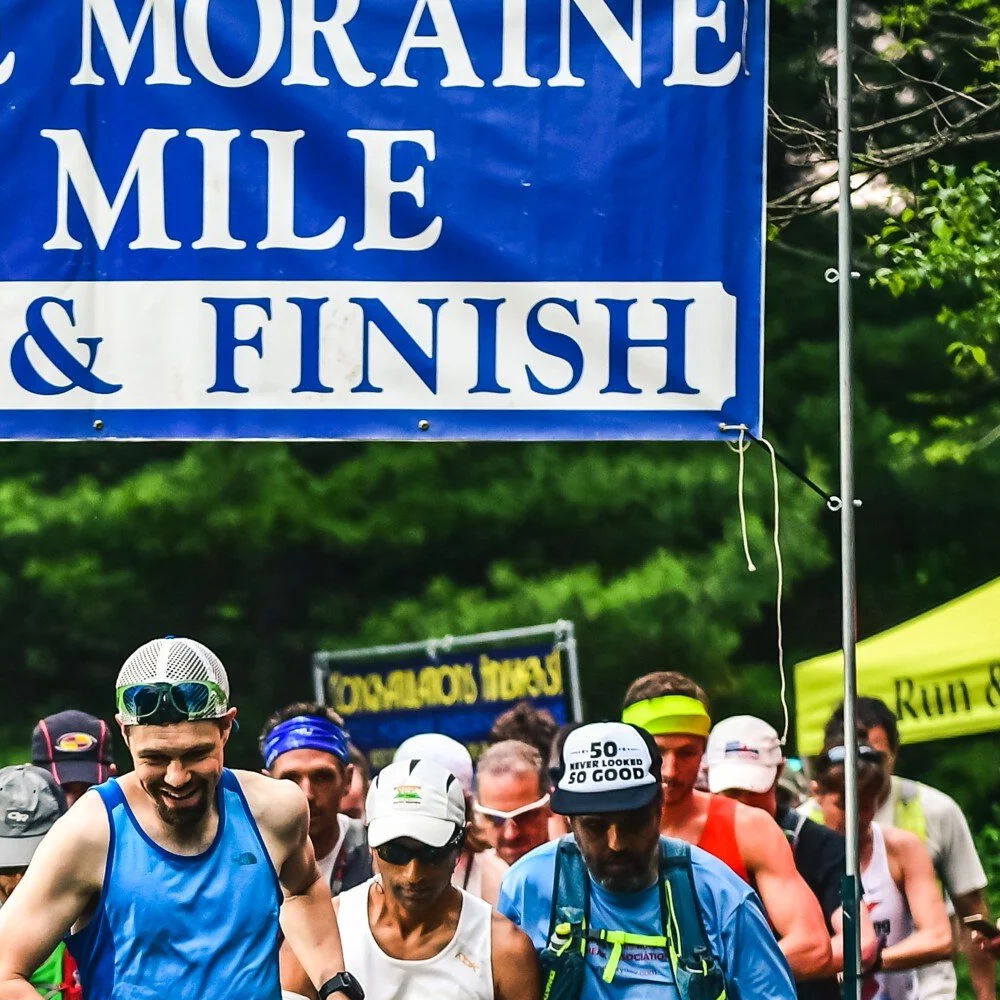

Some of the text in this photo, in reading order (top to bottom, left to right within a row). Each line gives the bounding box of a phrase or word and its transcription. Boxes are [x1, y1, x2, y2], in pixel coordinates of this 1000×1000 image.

[70, 0, 741, 89] MORAINE
[40, 128, 442, 251] MILE
[10, 296, 122, 395] &
[202, 296, 700, 395] FINISH
[893, 677, 971, 721] Run
[570, 759, 643, 771] NEVER LOOKED
[590, 741, 618, 759] 50
[568, 767, 644, 784] SO GOOD
